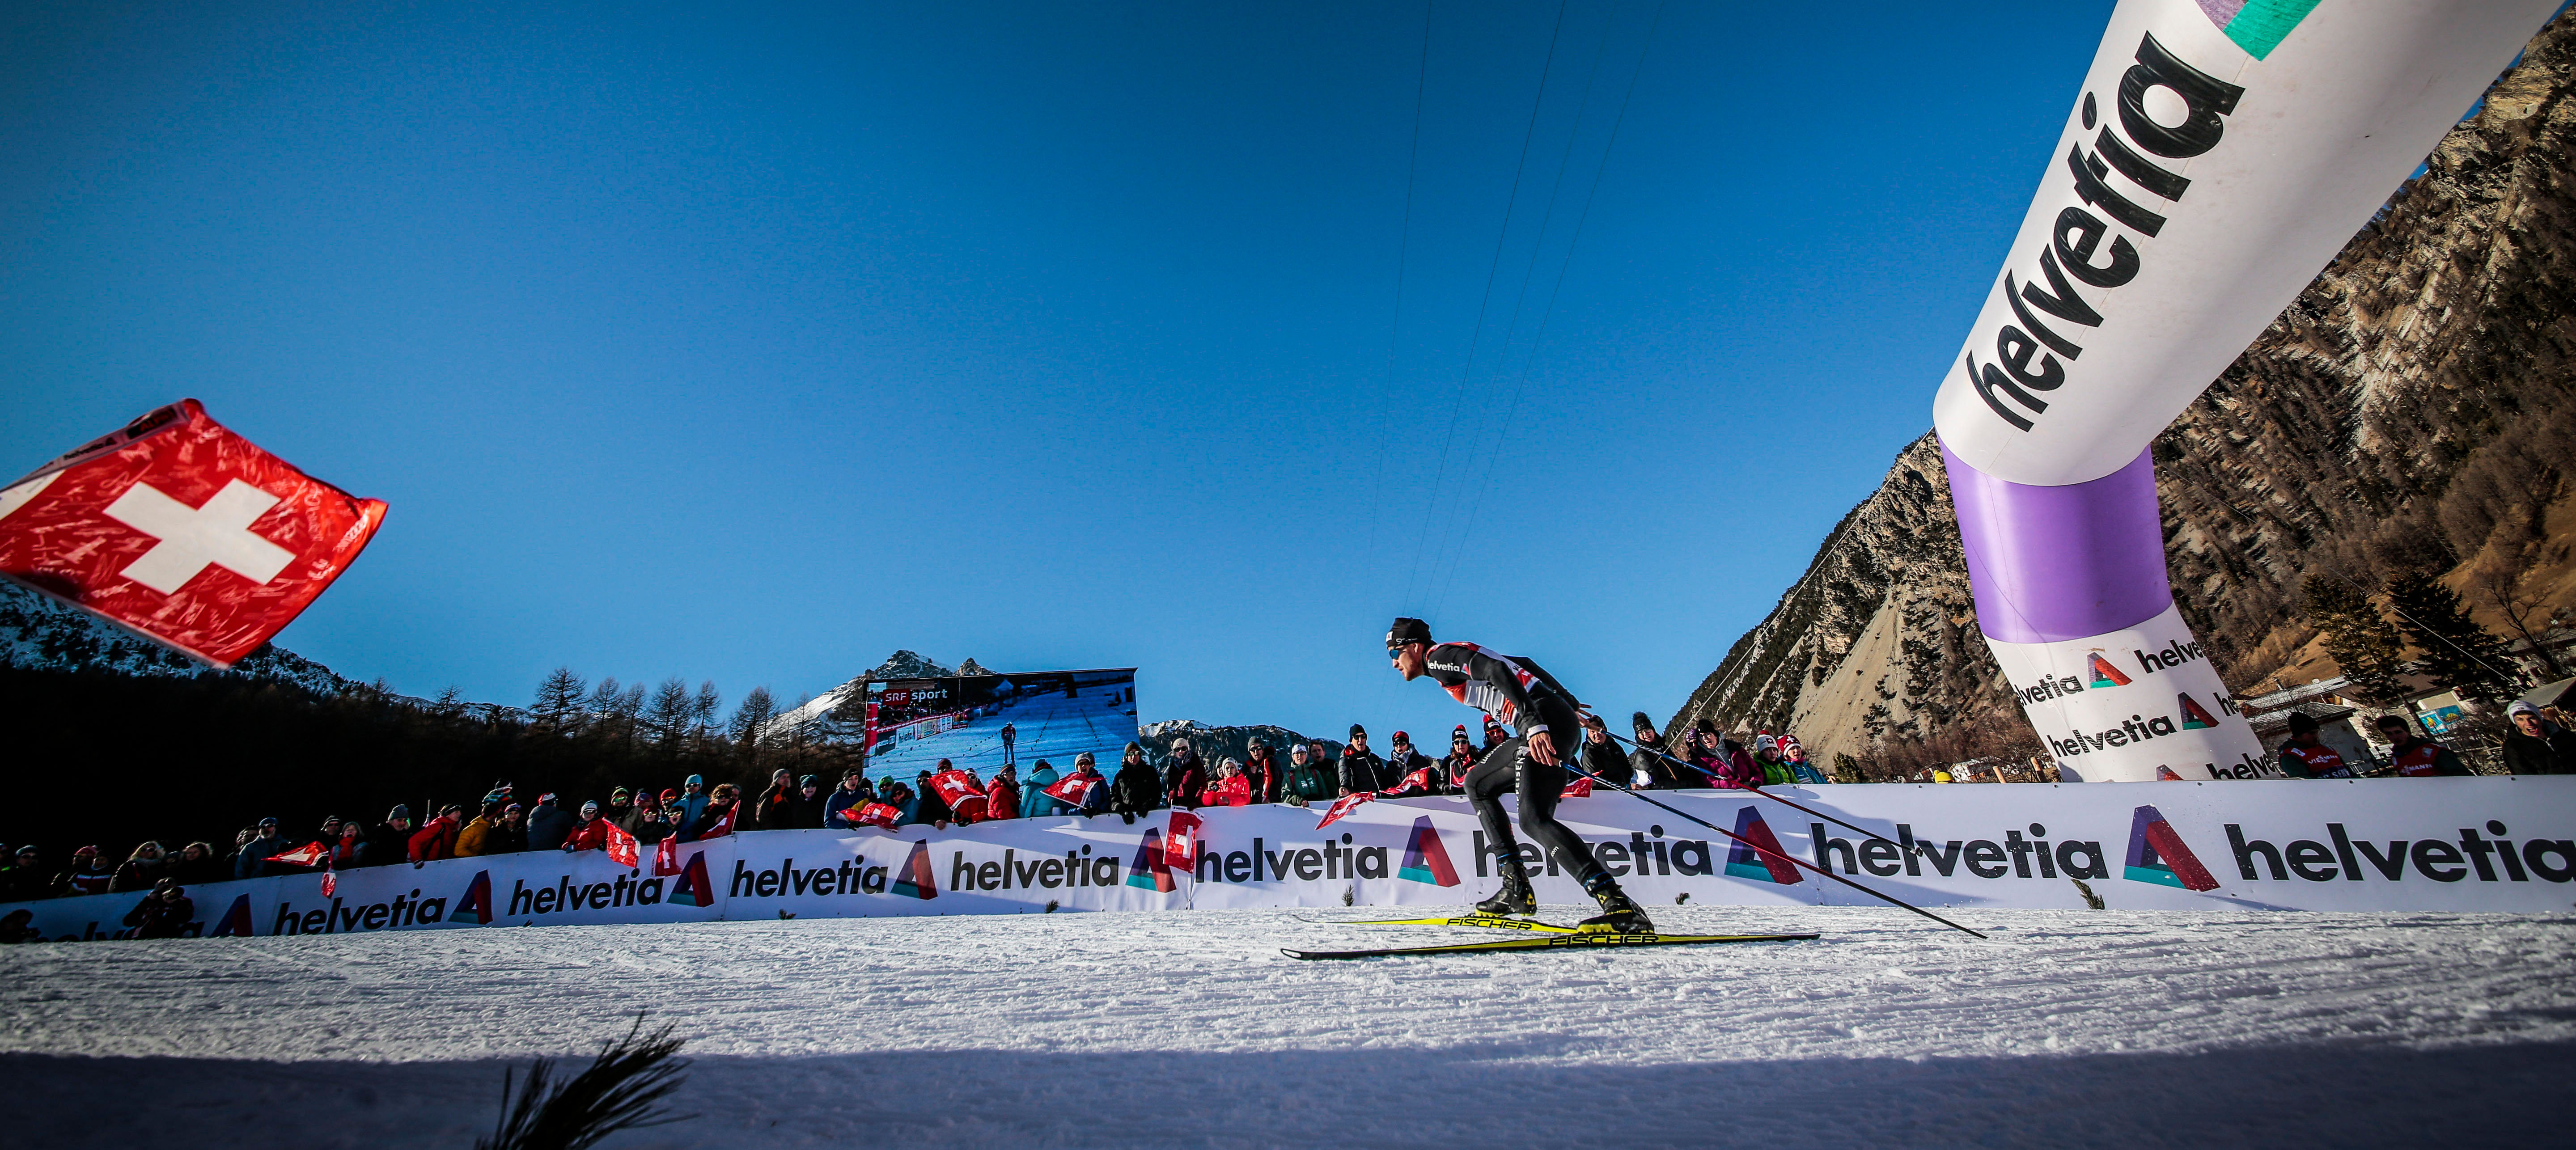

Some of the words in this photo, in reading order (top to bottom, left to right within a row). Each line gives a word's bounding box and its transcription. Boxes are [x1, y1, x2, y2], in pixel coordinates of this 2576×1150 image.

[1966, 30, 2246, 432] helvetia
[886, 692, 907, 702] SRF
[911, 689, 948, 702] sport
[2047, 714, 2177, 759] helvetia
[951, 844, 1119, 891] helvetia
[1195, 833, 1388, 883] helvetia
[1474, 824, 1713, 877] heetia
[1811, 823, 2110, 879] helvetia
[2224, 820, 2576, 883] helvetia
[508, 868, 664, 916] helvetia
[729, 854, 888, 898] helvetia
[273, 888, 447, 936] helvetia
[1446, 918, 1532, 930] FISCHER
[1549, 935, 1659, 947] FISCHER
